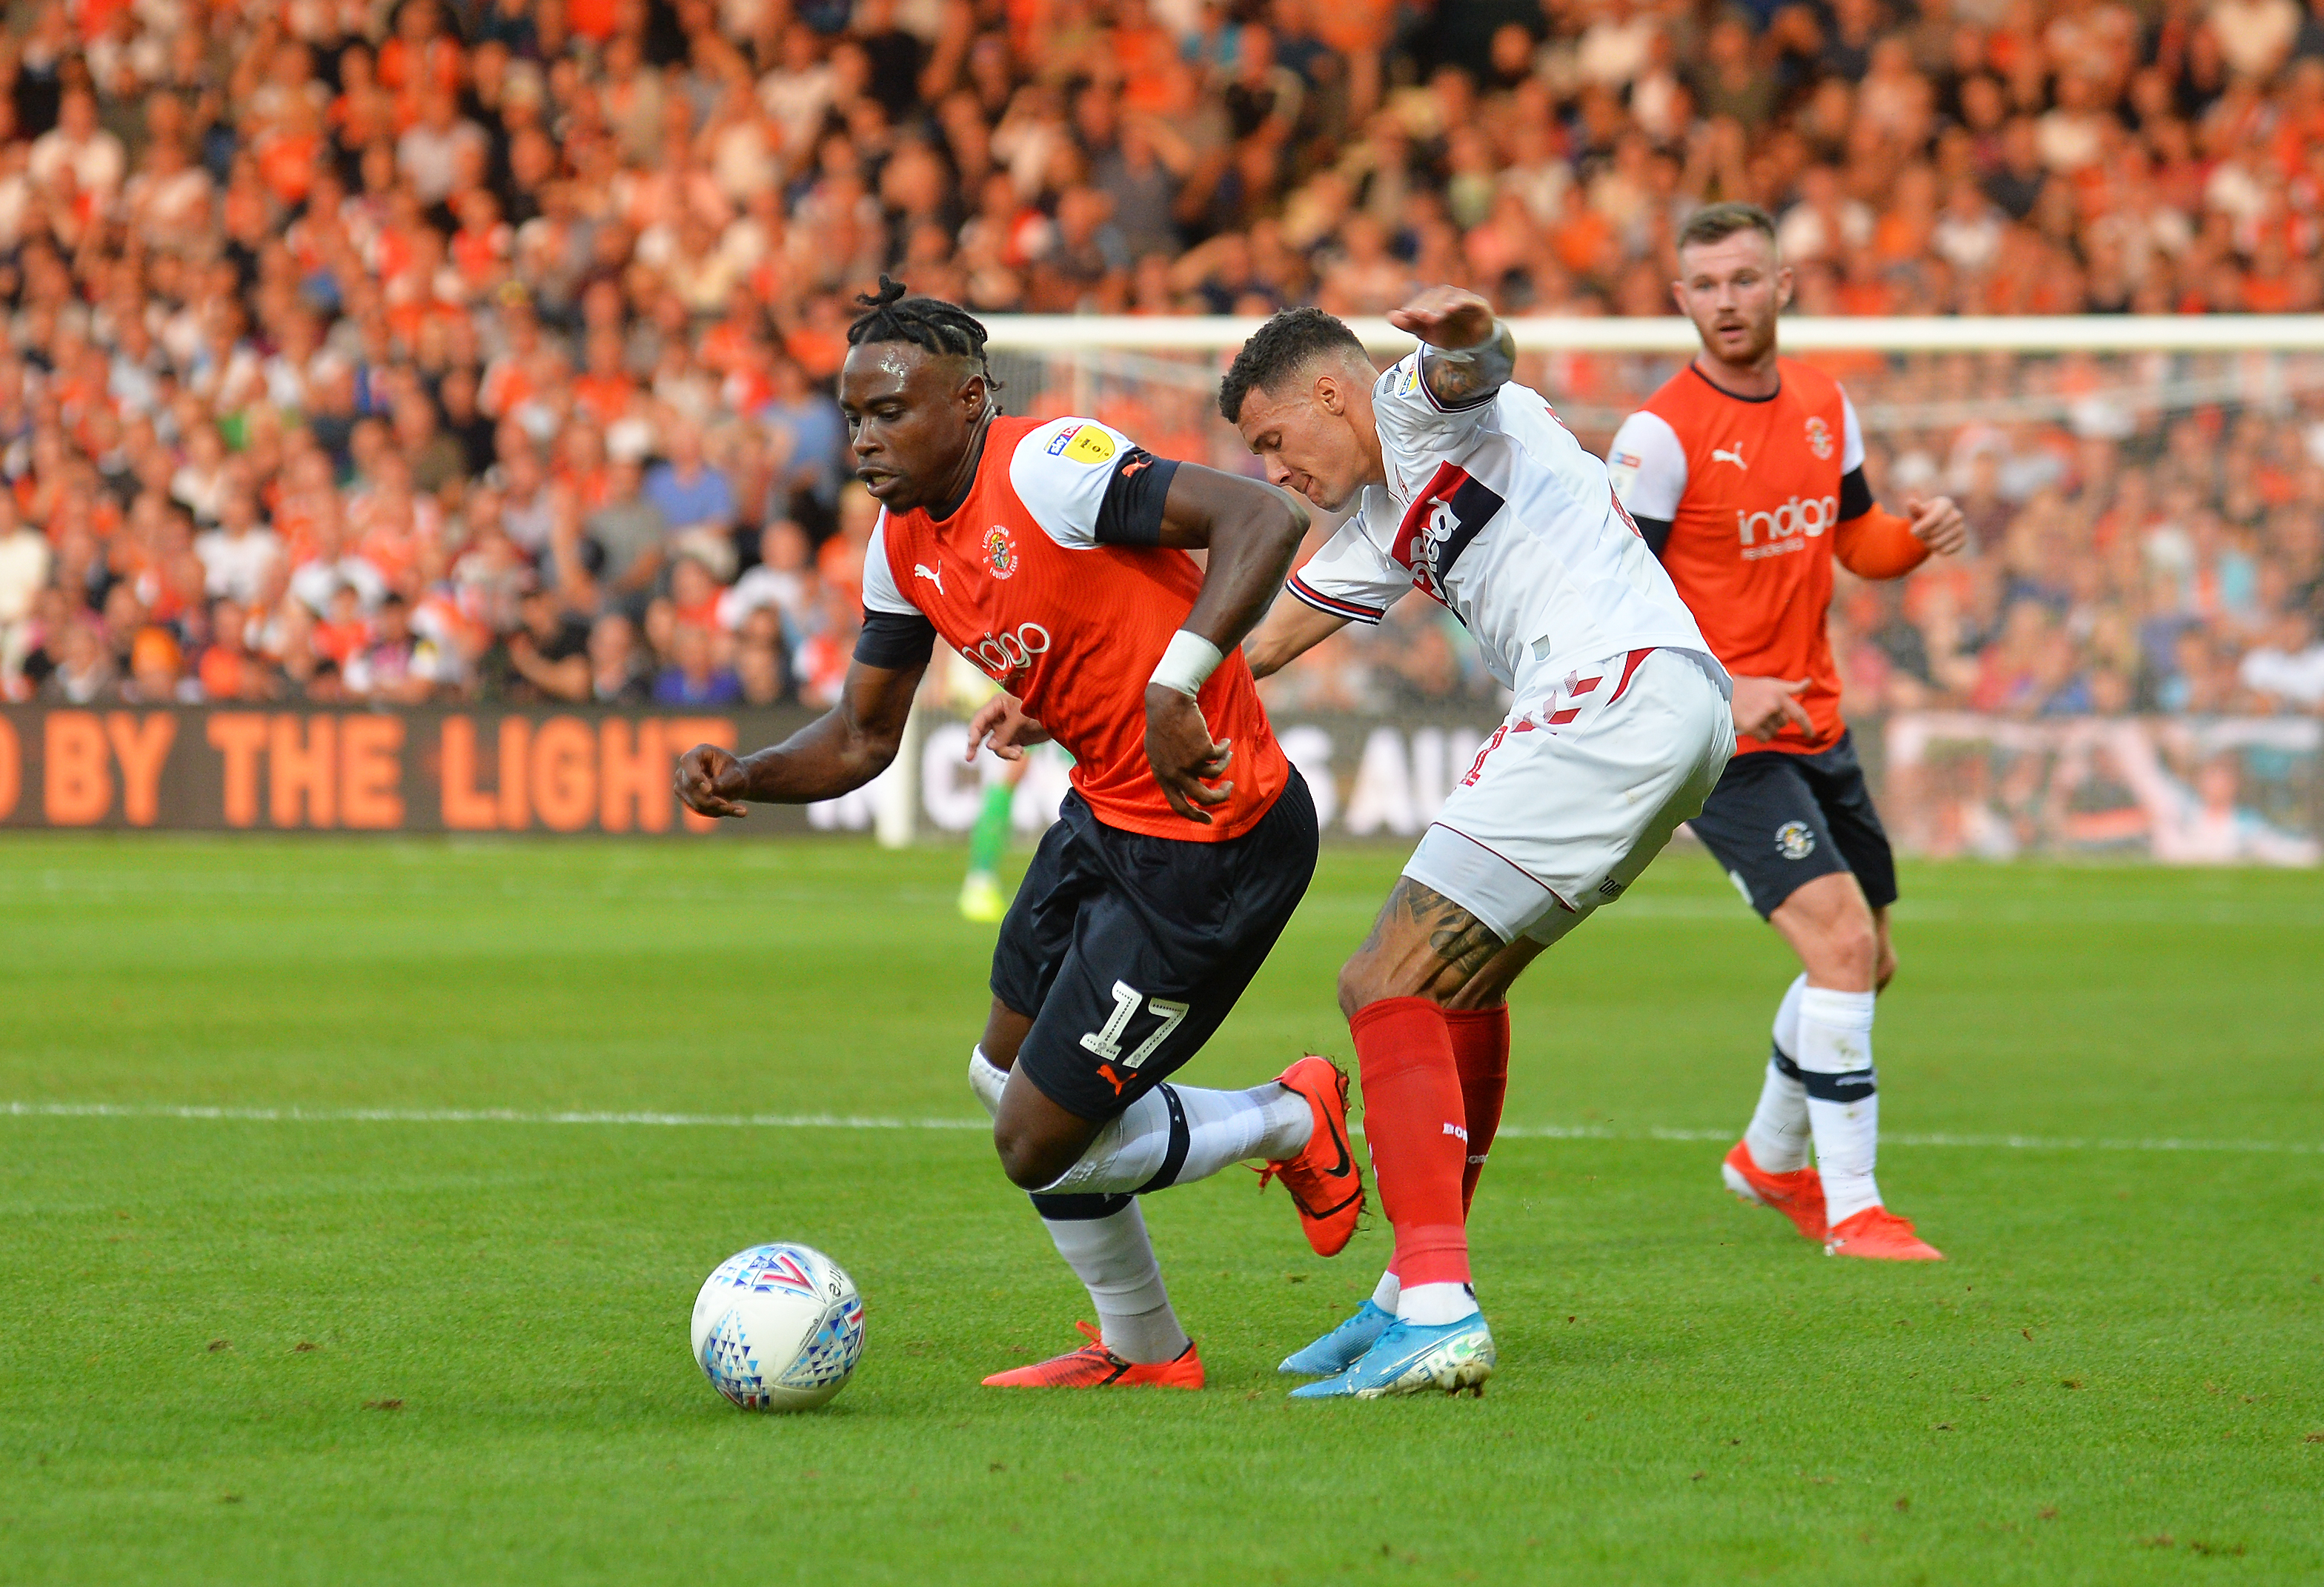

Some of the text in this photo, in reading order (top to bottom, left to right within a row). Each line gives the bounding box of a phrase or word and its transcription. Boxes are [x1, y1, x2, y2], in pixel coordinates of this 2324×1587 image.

[1049, 436, 1069, 453] sky
[1736, 495, 1839, 545] indigo
[44, 709, 177, 827] BY
[206, 711, 405, 830] THE
[440, 713, 738, 834] LIGHT
[1079, 978, 1190, 1069] 17
